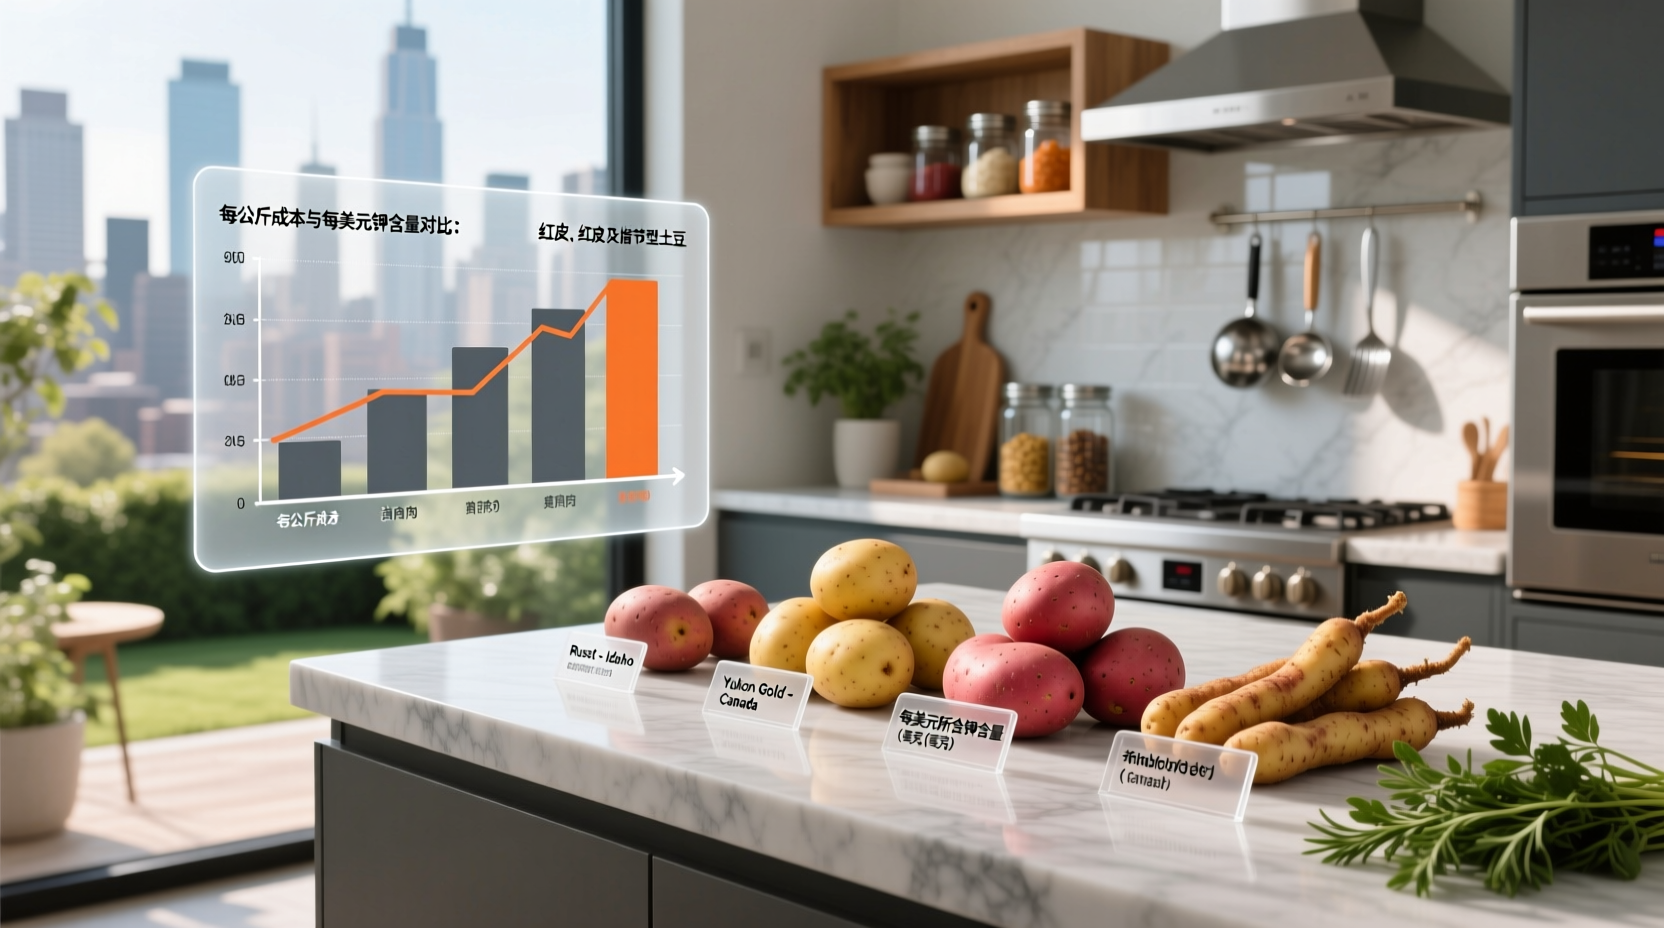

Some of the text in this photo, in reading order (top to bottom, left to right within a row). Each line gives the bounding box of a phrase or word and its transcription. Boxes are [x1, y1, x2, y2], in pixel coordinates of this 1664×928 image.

[237, 497, 245, 509] 0
[758, 682, 787, 699] Gold
[719, 692, 758, 711] Canada
